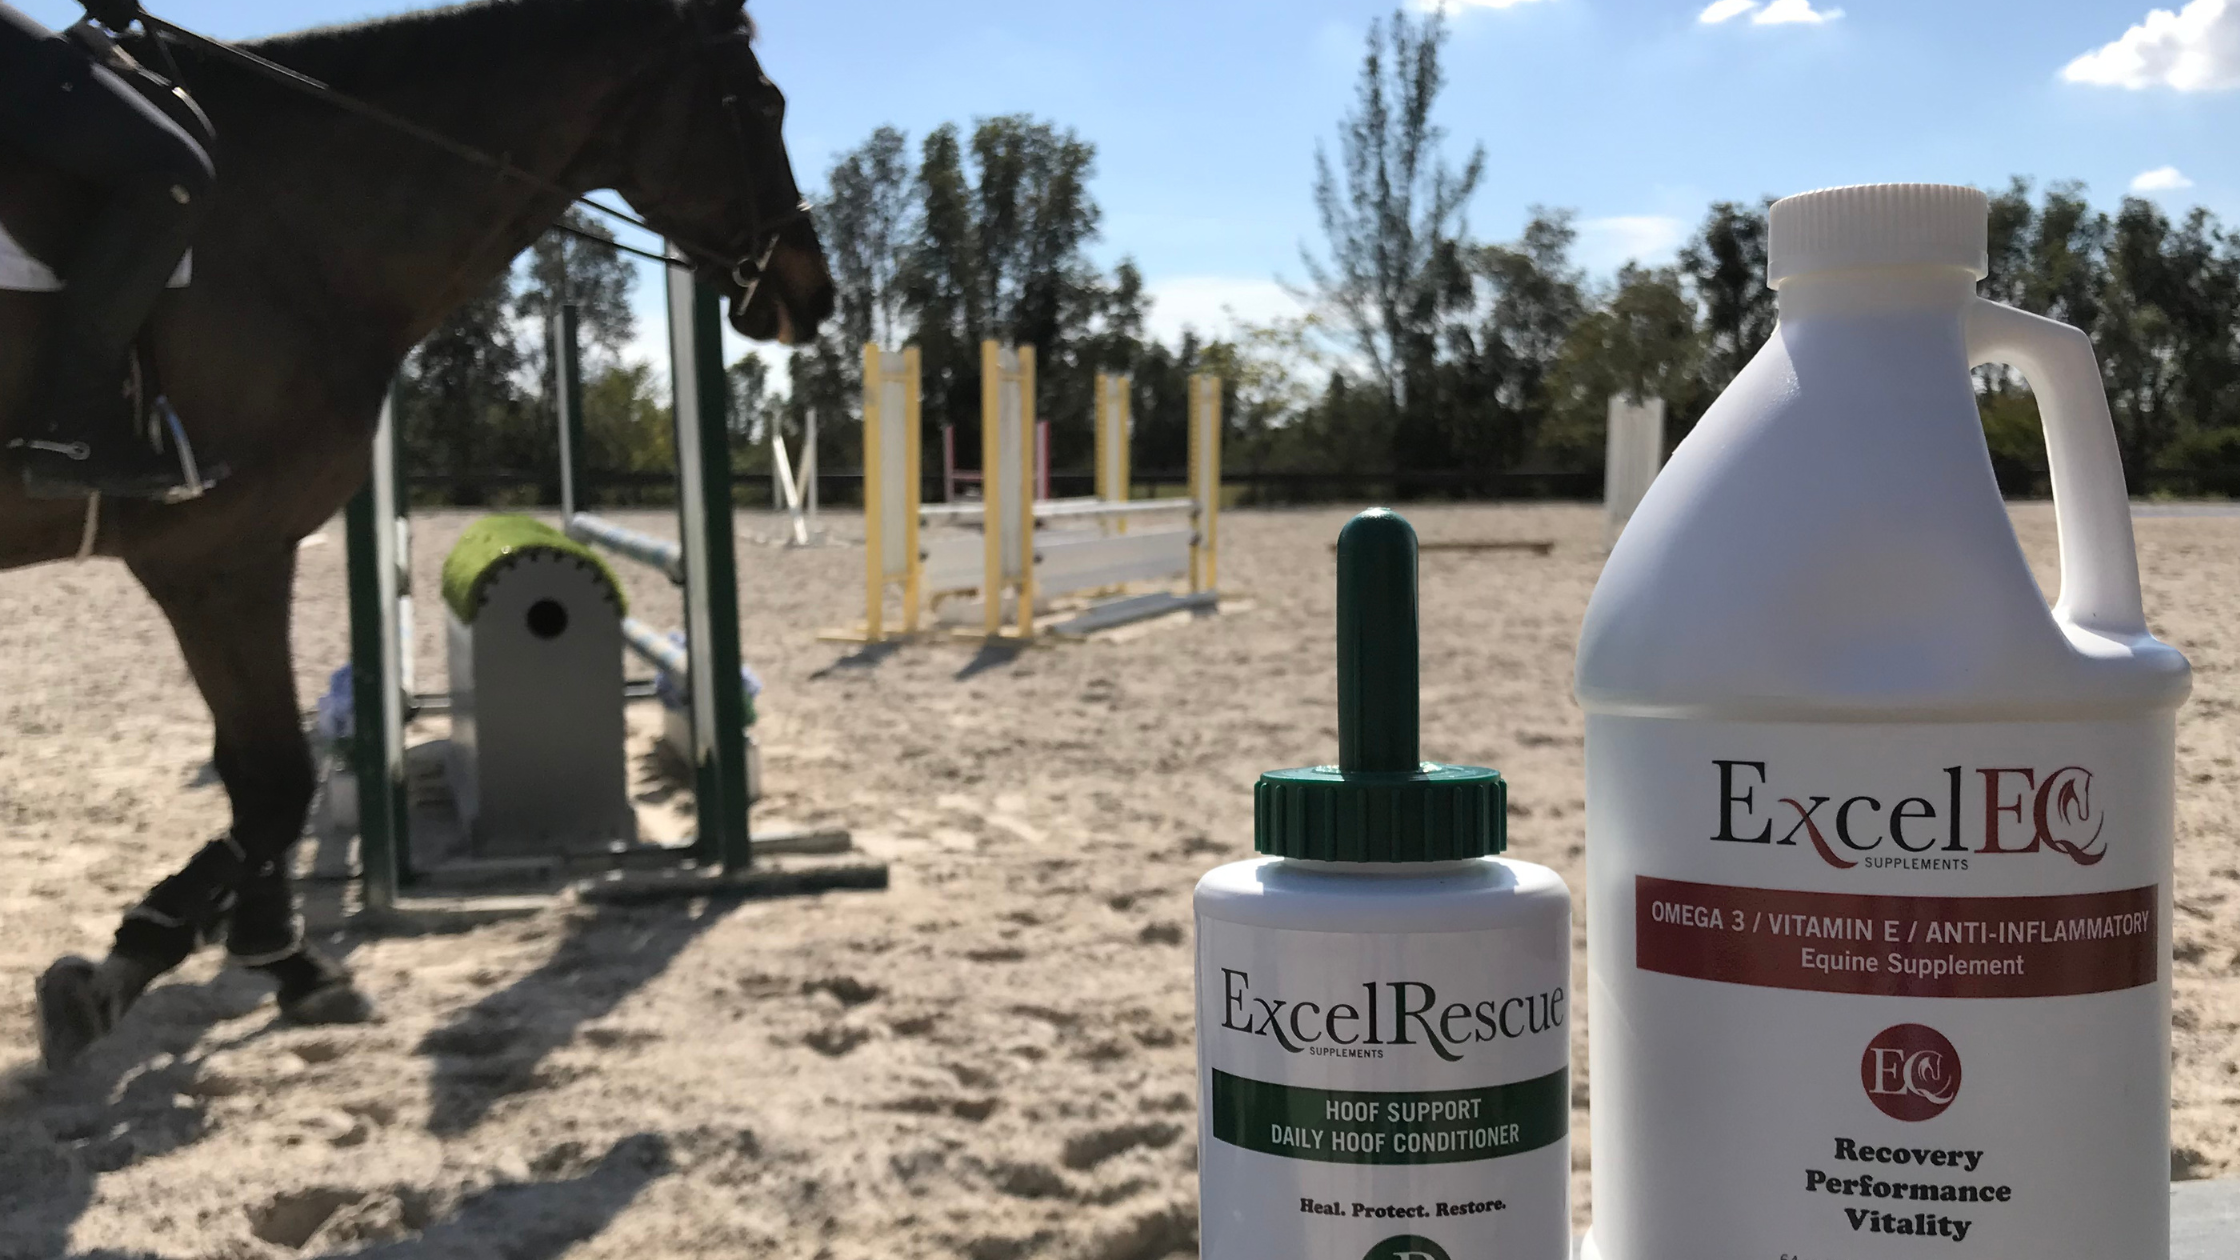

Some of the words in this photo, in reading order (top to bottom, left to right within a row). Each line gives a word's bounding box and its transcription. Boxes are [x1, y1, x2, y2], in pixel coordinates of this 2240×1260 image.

[1864, 856, 1969, 871] SUPPLEMENTS
[1651, 900, 1724, 930] OMEGA
[1731, 910, 1746, 932] 3
[1752, 911, 1762, 933] /
[1768, 912, 1873, 941] VITAMIN
[1884, 920, 1900, 942] E
[1907, 920, 1918, 943] /
[1926, 910, 2150, 944] ANTI-INFLAMMATORY
[1801, 947, 1879, 975] Equine
[1887, 952, 2025, 980] Supplement
[1221, 967, 1565, 1062] ExcelRescue
[1309, 1046, 1384, 1059] SUPPLEMENTS
[1325, 1101, 1380, 1122] HOOF
[1387, 1098, 1482, 1122] SUPPORT
[1271, 1123, 1324, 1150] DAILY
[1332, 1132, 1385, 1153] HOOF
[1393, 1123, 1520, 1153] CONDITIONER
[1834, 1137, 1984, 1172] Recovery
[1805, 1169, 2012, 1203] Performance
[1300, 1198, 1346, 1217] Heal.
[1352, 1203, 1430, 1218] Protect.
[1436, 1199, 1506, 1218] Restore.
[1844, 1208, 1972, 1242] Vitality
